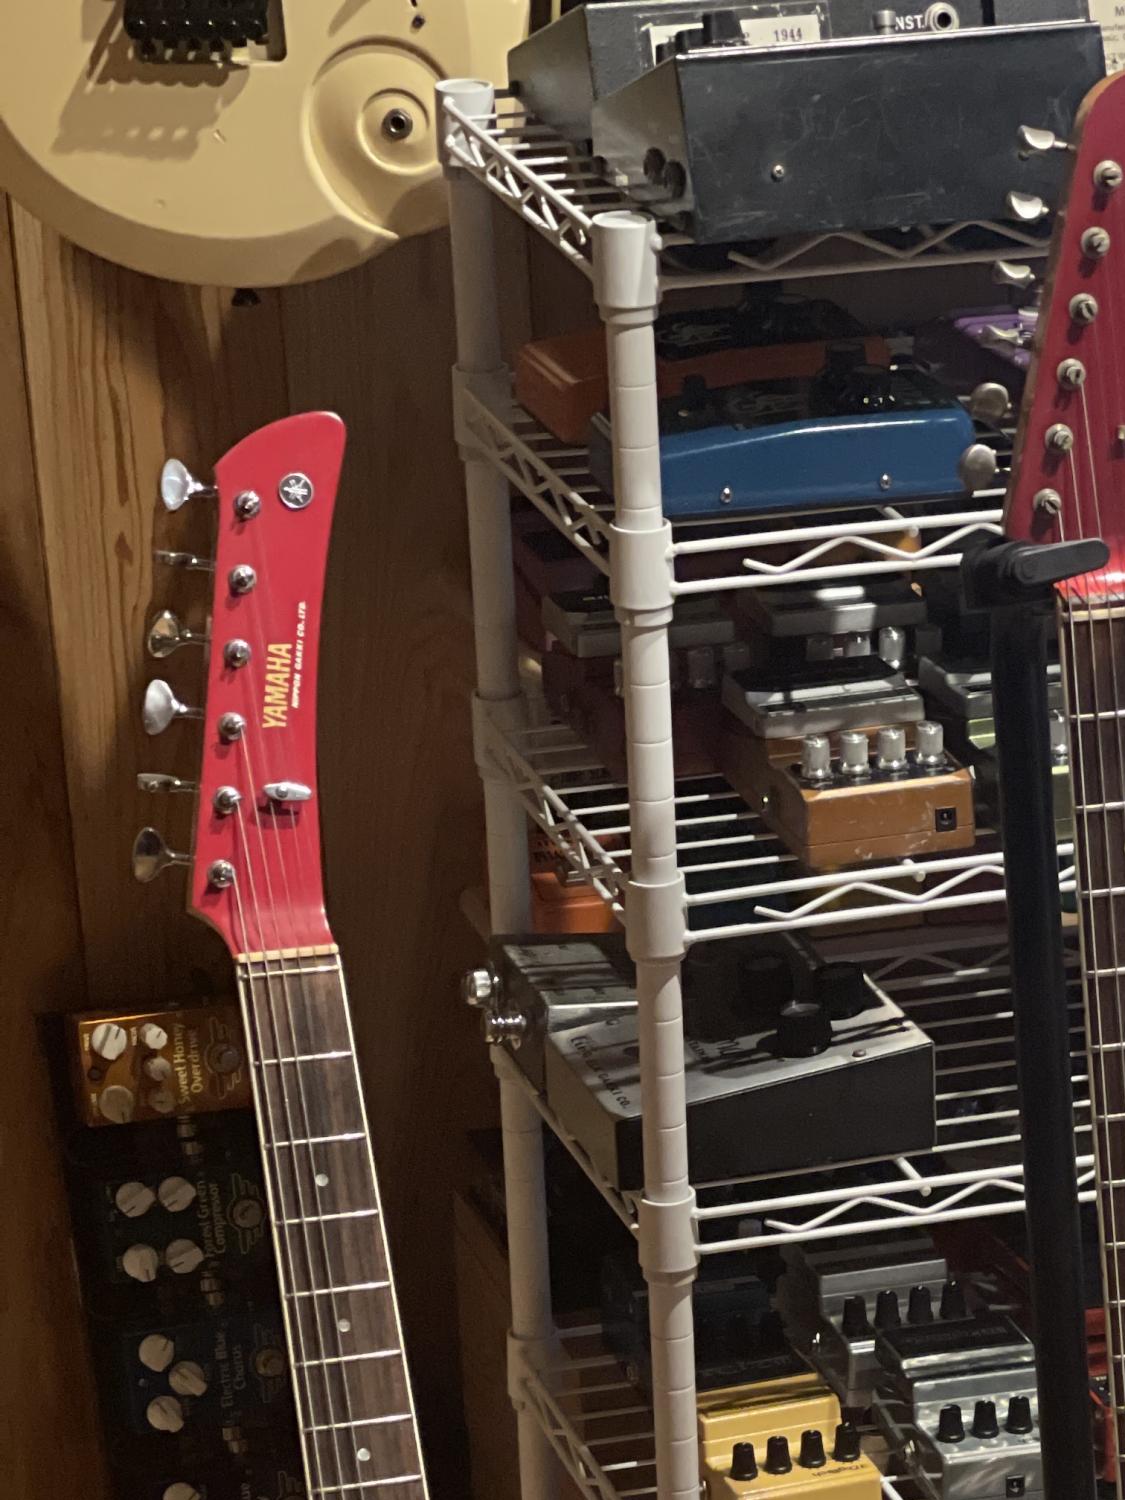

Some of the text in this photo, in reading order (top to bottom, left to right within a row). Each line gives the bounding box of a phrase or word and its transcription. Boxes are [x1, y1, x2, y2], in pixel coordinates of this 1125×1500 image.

[773, 27, 803, 43] 1944
[893, 15, 926, 31] NST.
[294, 639, 304, 671] GAKKI
[261, 642, 292, 729] YAMAHA
[290, 673, 303, 709] NIPPON
[171, 1022, 192, 1105] Sweet Honey
[194, 1178, 213, 1219] Green
[231, 1343, 248, 1391] Chorus
